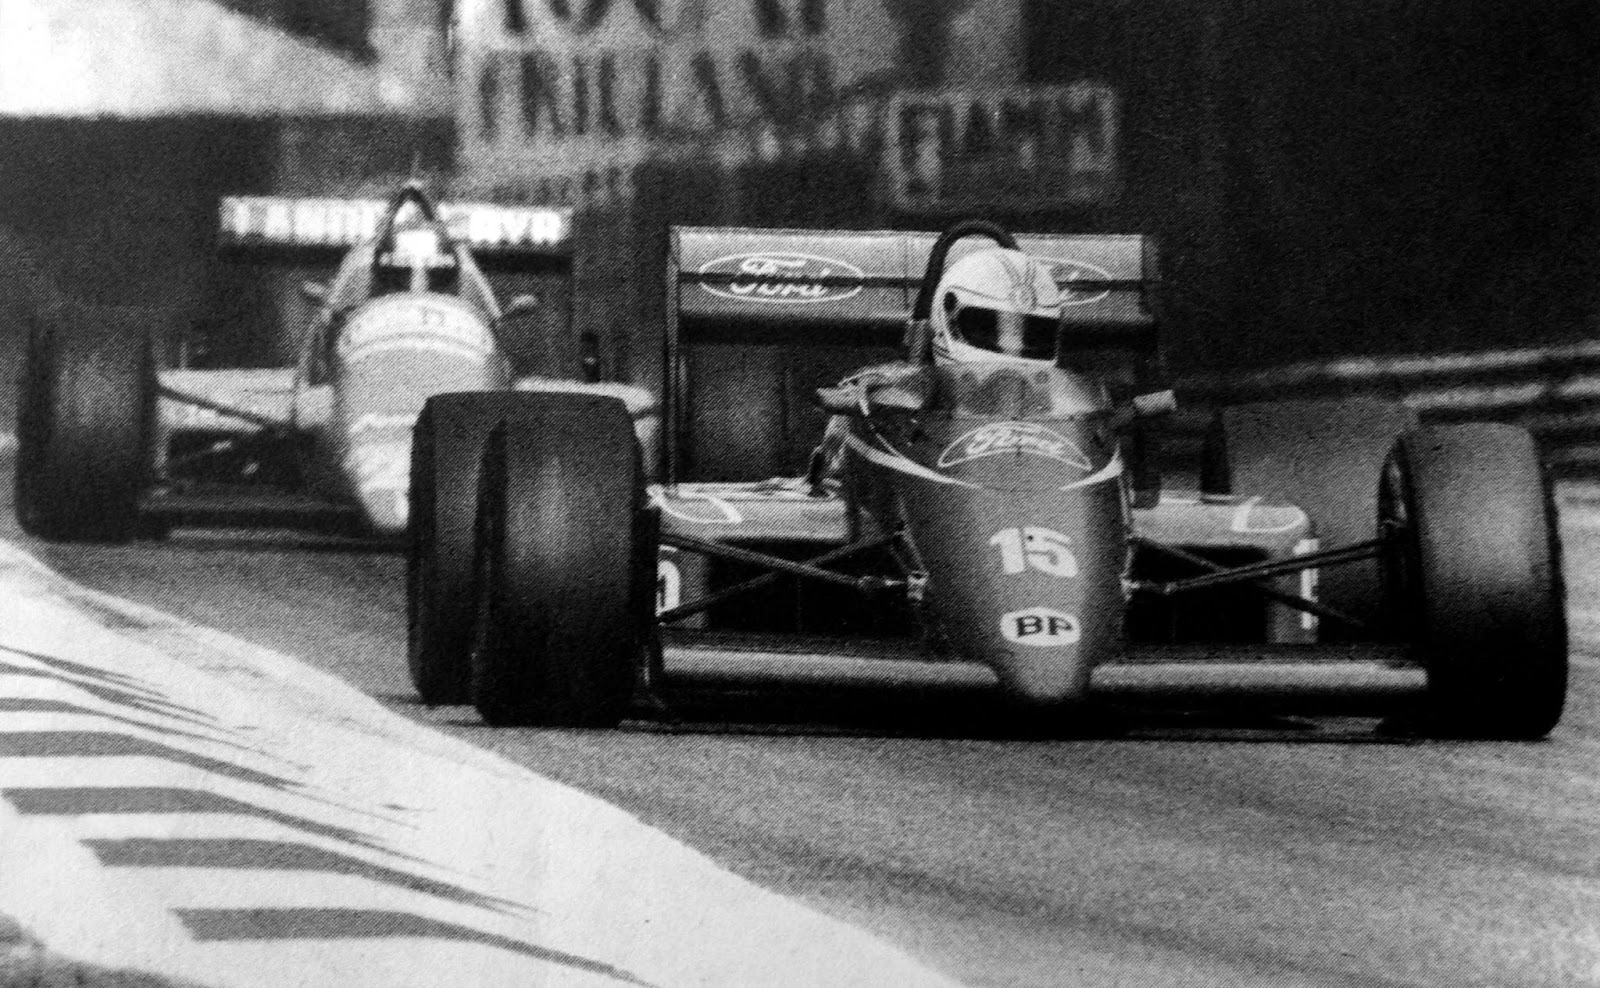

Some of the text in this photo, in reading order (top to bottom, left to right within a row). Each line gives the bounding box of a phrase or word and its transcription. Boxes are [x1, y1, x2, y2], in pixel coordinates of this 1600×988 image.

[729, 256, 831, 298] Ford
[989, 526, 1079, 578] 15
[1015, 614, 1074, 639] BP
